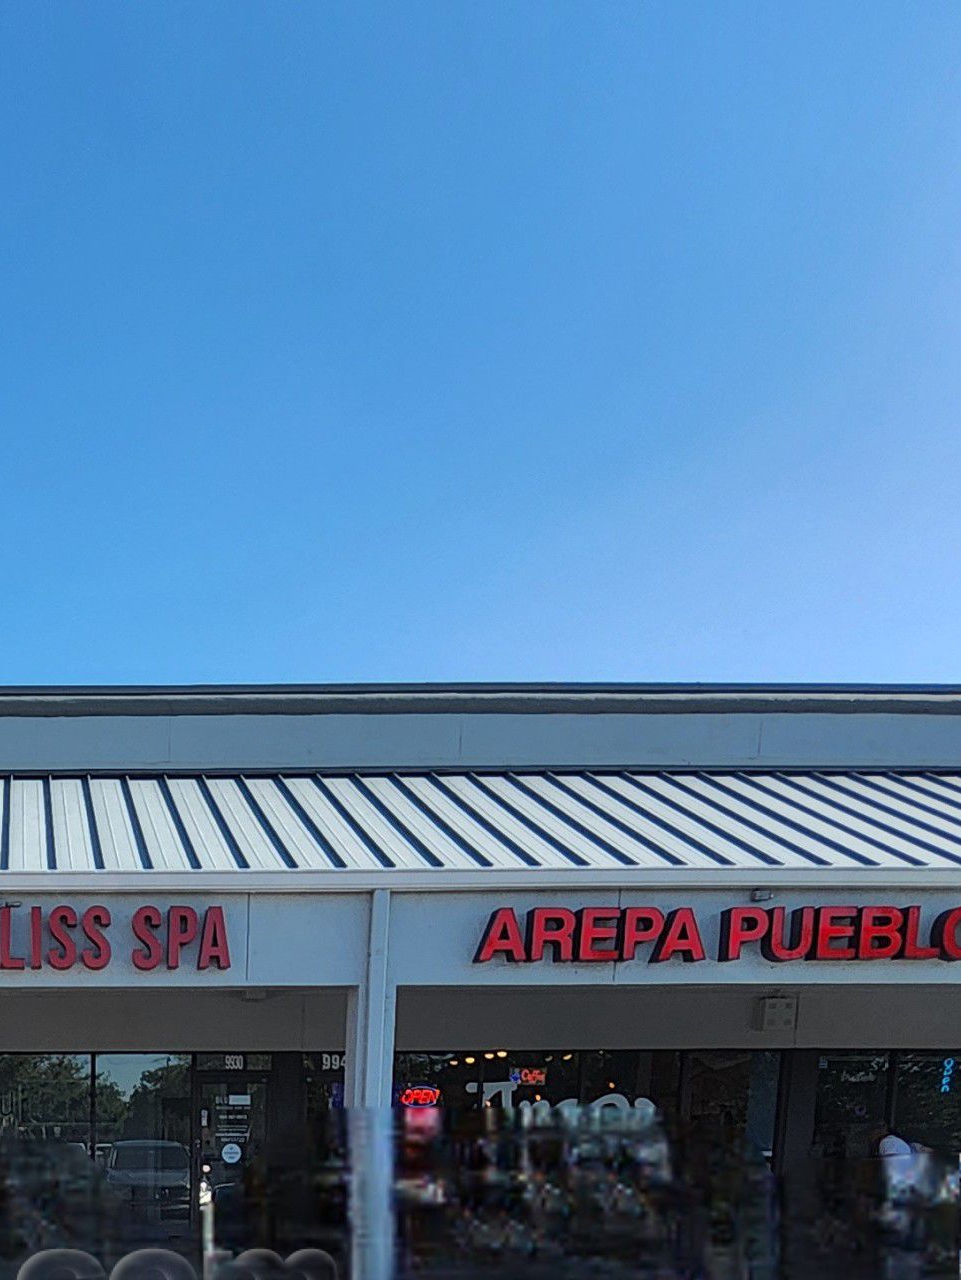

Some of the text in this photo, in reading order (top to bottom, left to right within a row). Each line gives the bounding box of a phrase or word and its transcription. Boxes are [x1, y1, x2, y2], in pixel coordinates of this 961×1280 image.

[132, 905, 231, 970] SPA
[473, 907, 706, 963] AREPA
[402, 1088, 440, 1105] OPEN
